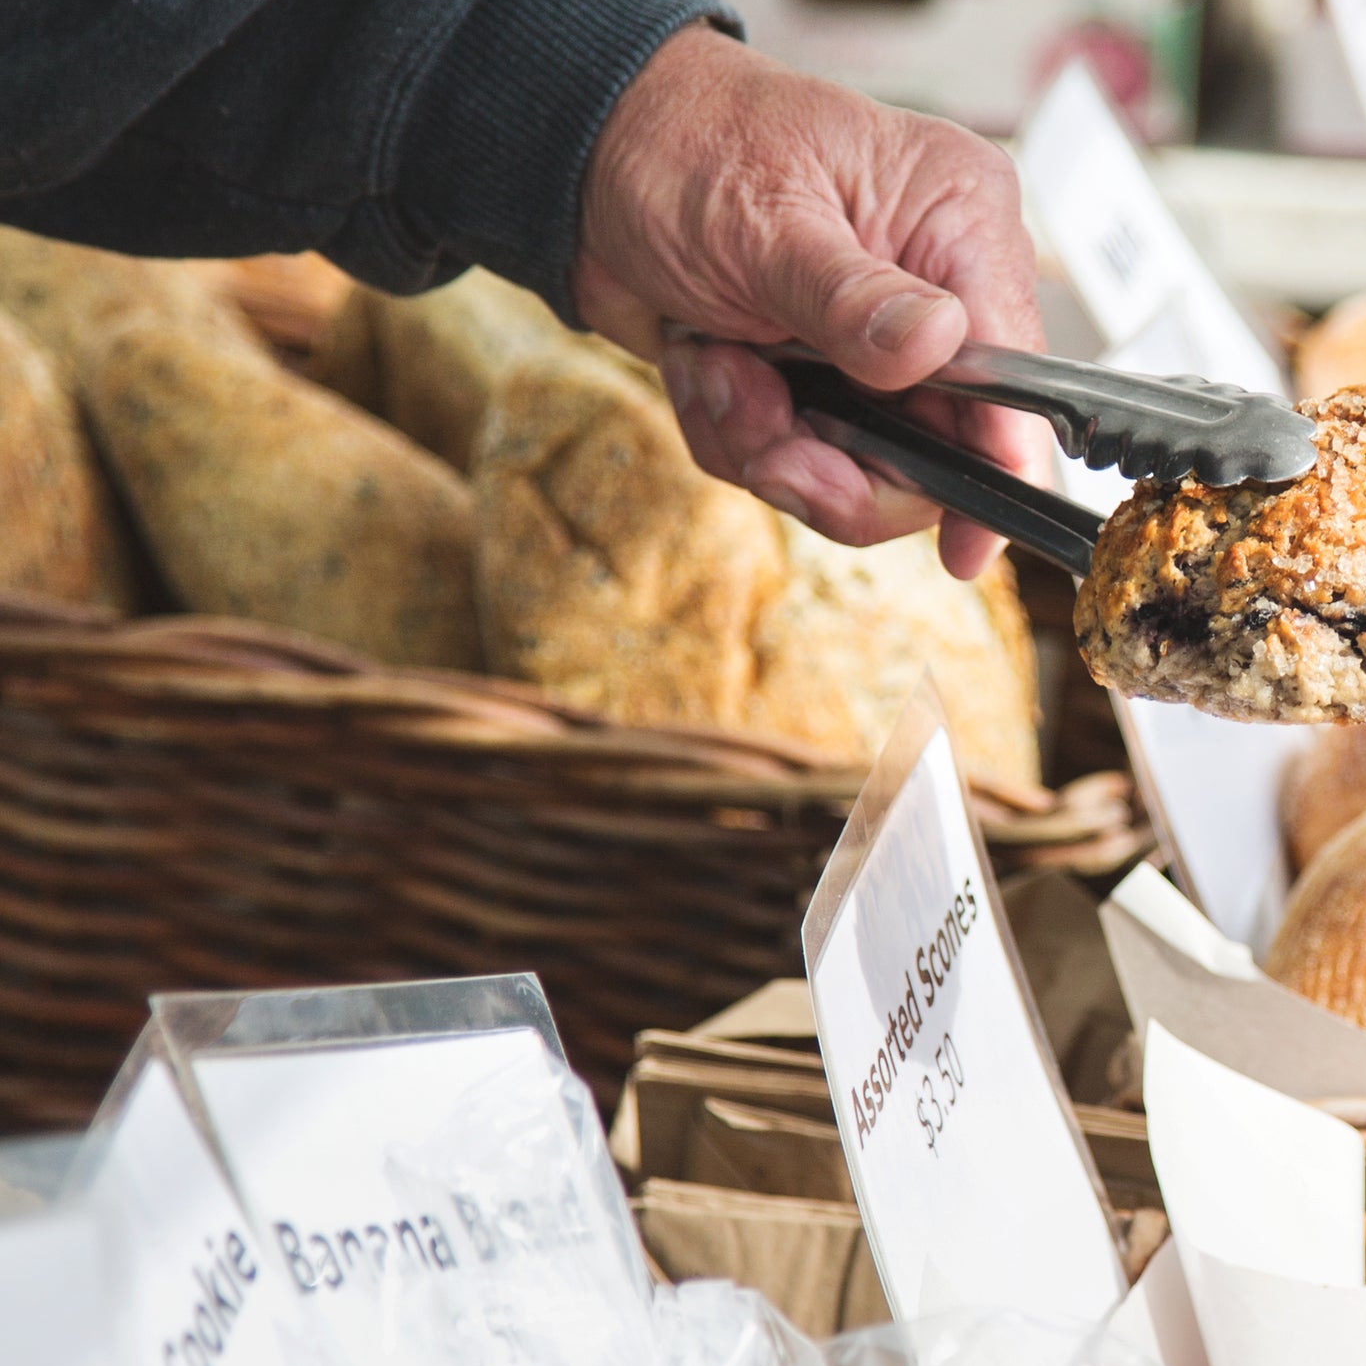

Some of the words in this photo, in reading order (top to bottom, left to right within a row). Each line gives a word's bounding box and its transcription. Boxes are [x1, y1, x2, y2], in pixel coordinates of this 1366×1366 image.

[852, 970, 923, 1150] Assorted
[916, 876, 977, 1009] Scones
[914, 1032, 964, 1159] $3.50
[273, 1218, 458, 1295] Banana
